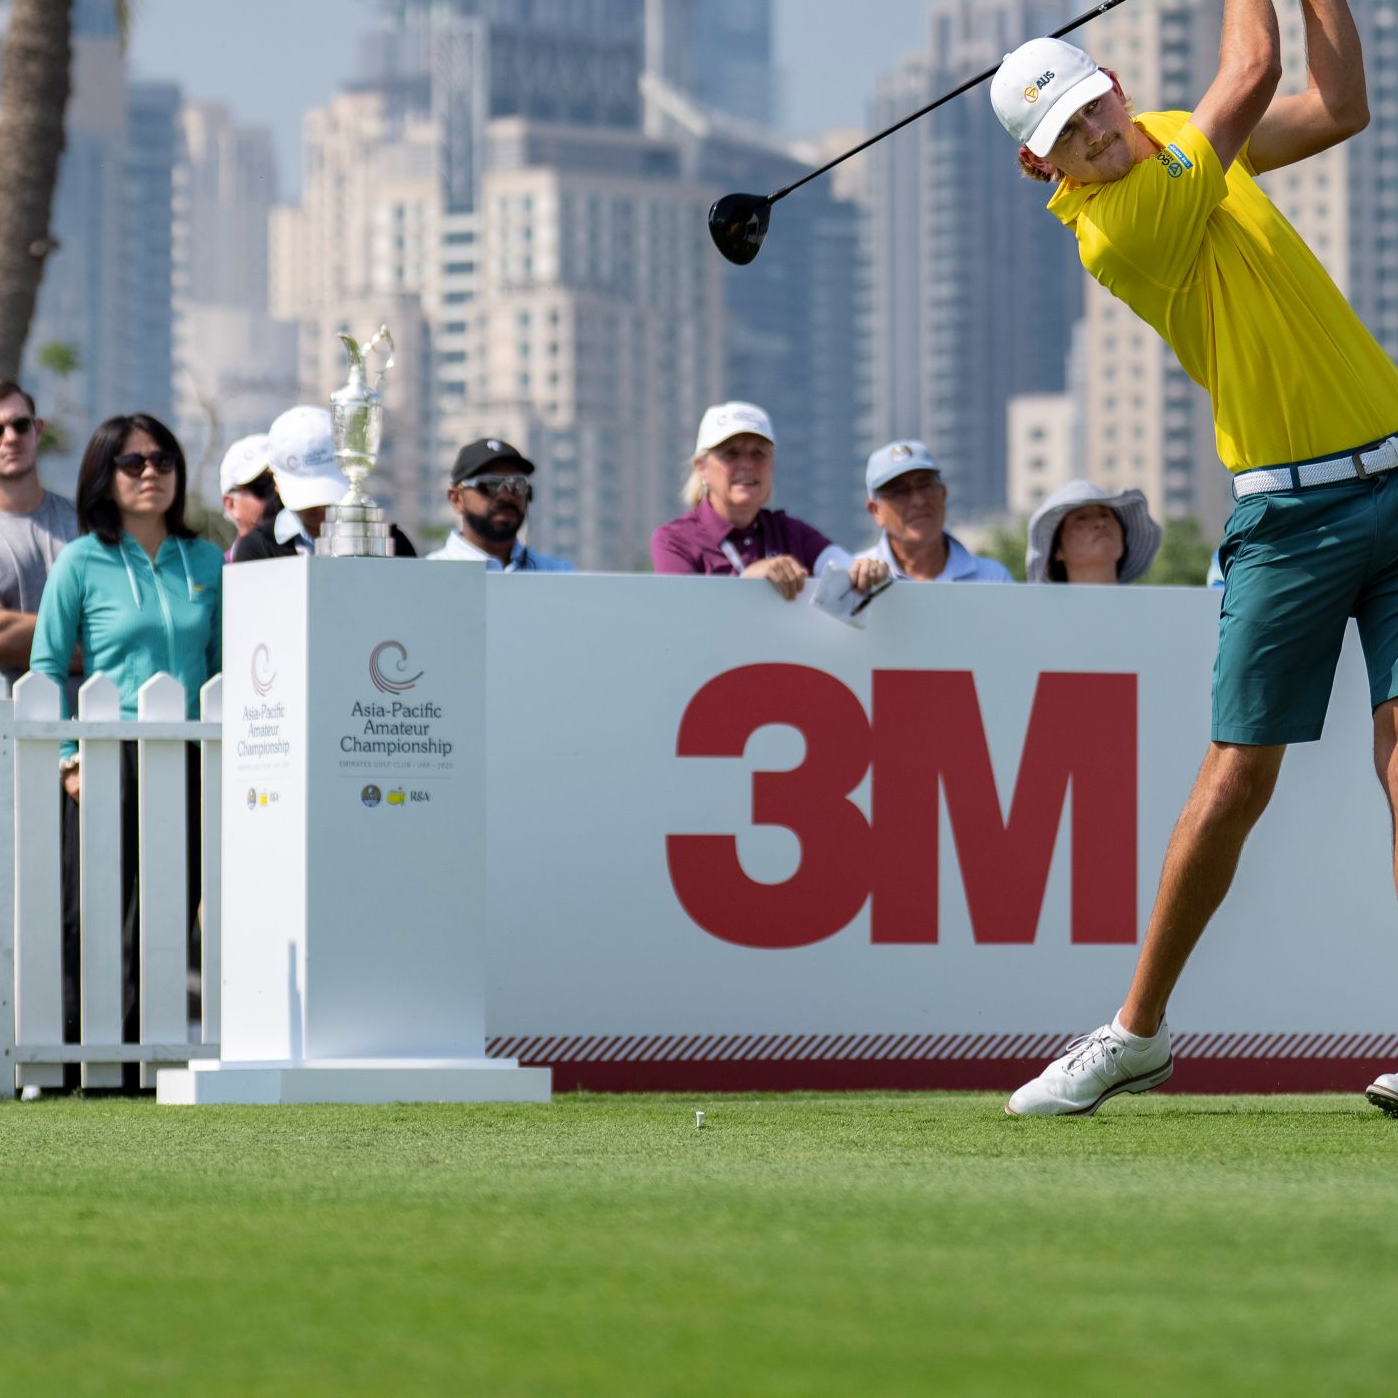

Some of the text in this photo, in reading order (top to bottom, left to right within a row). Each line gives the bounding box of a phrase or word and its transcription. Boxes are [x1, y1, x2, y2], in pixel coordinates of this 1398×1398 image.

[1036, 70, 1055, 90] AUS
[242, 703, 285, 721] Asia-Pacific
[351, 701, 442, 718] Asia-Pacific
[248, 723, 279, 738] Amateur
[363, 719, 429, 735] Amateur
[237, 739, 290, 758] Championship
[340, 736, 452, 757] Championship
[410, 790, 431, 802] R&A
[665, 662, 1138, 949] 3M
